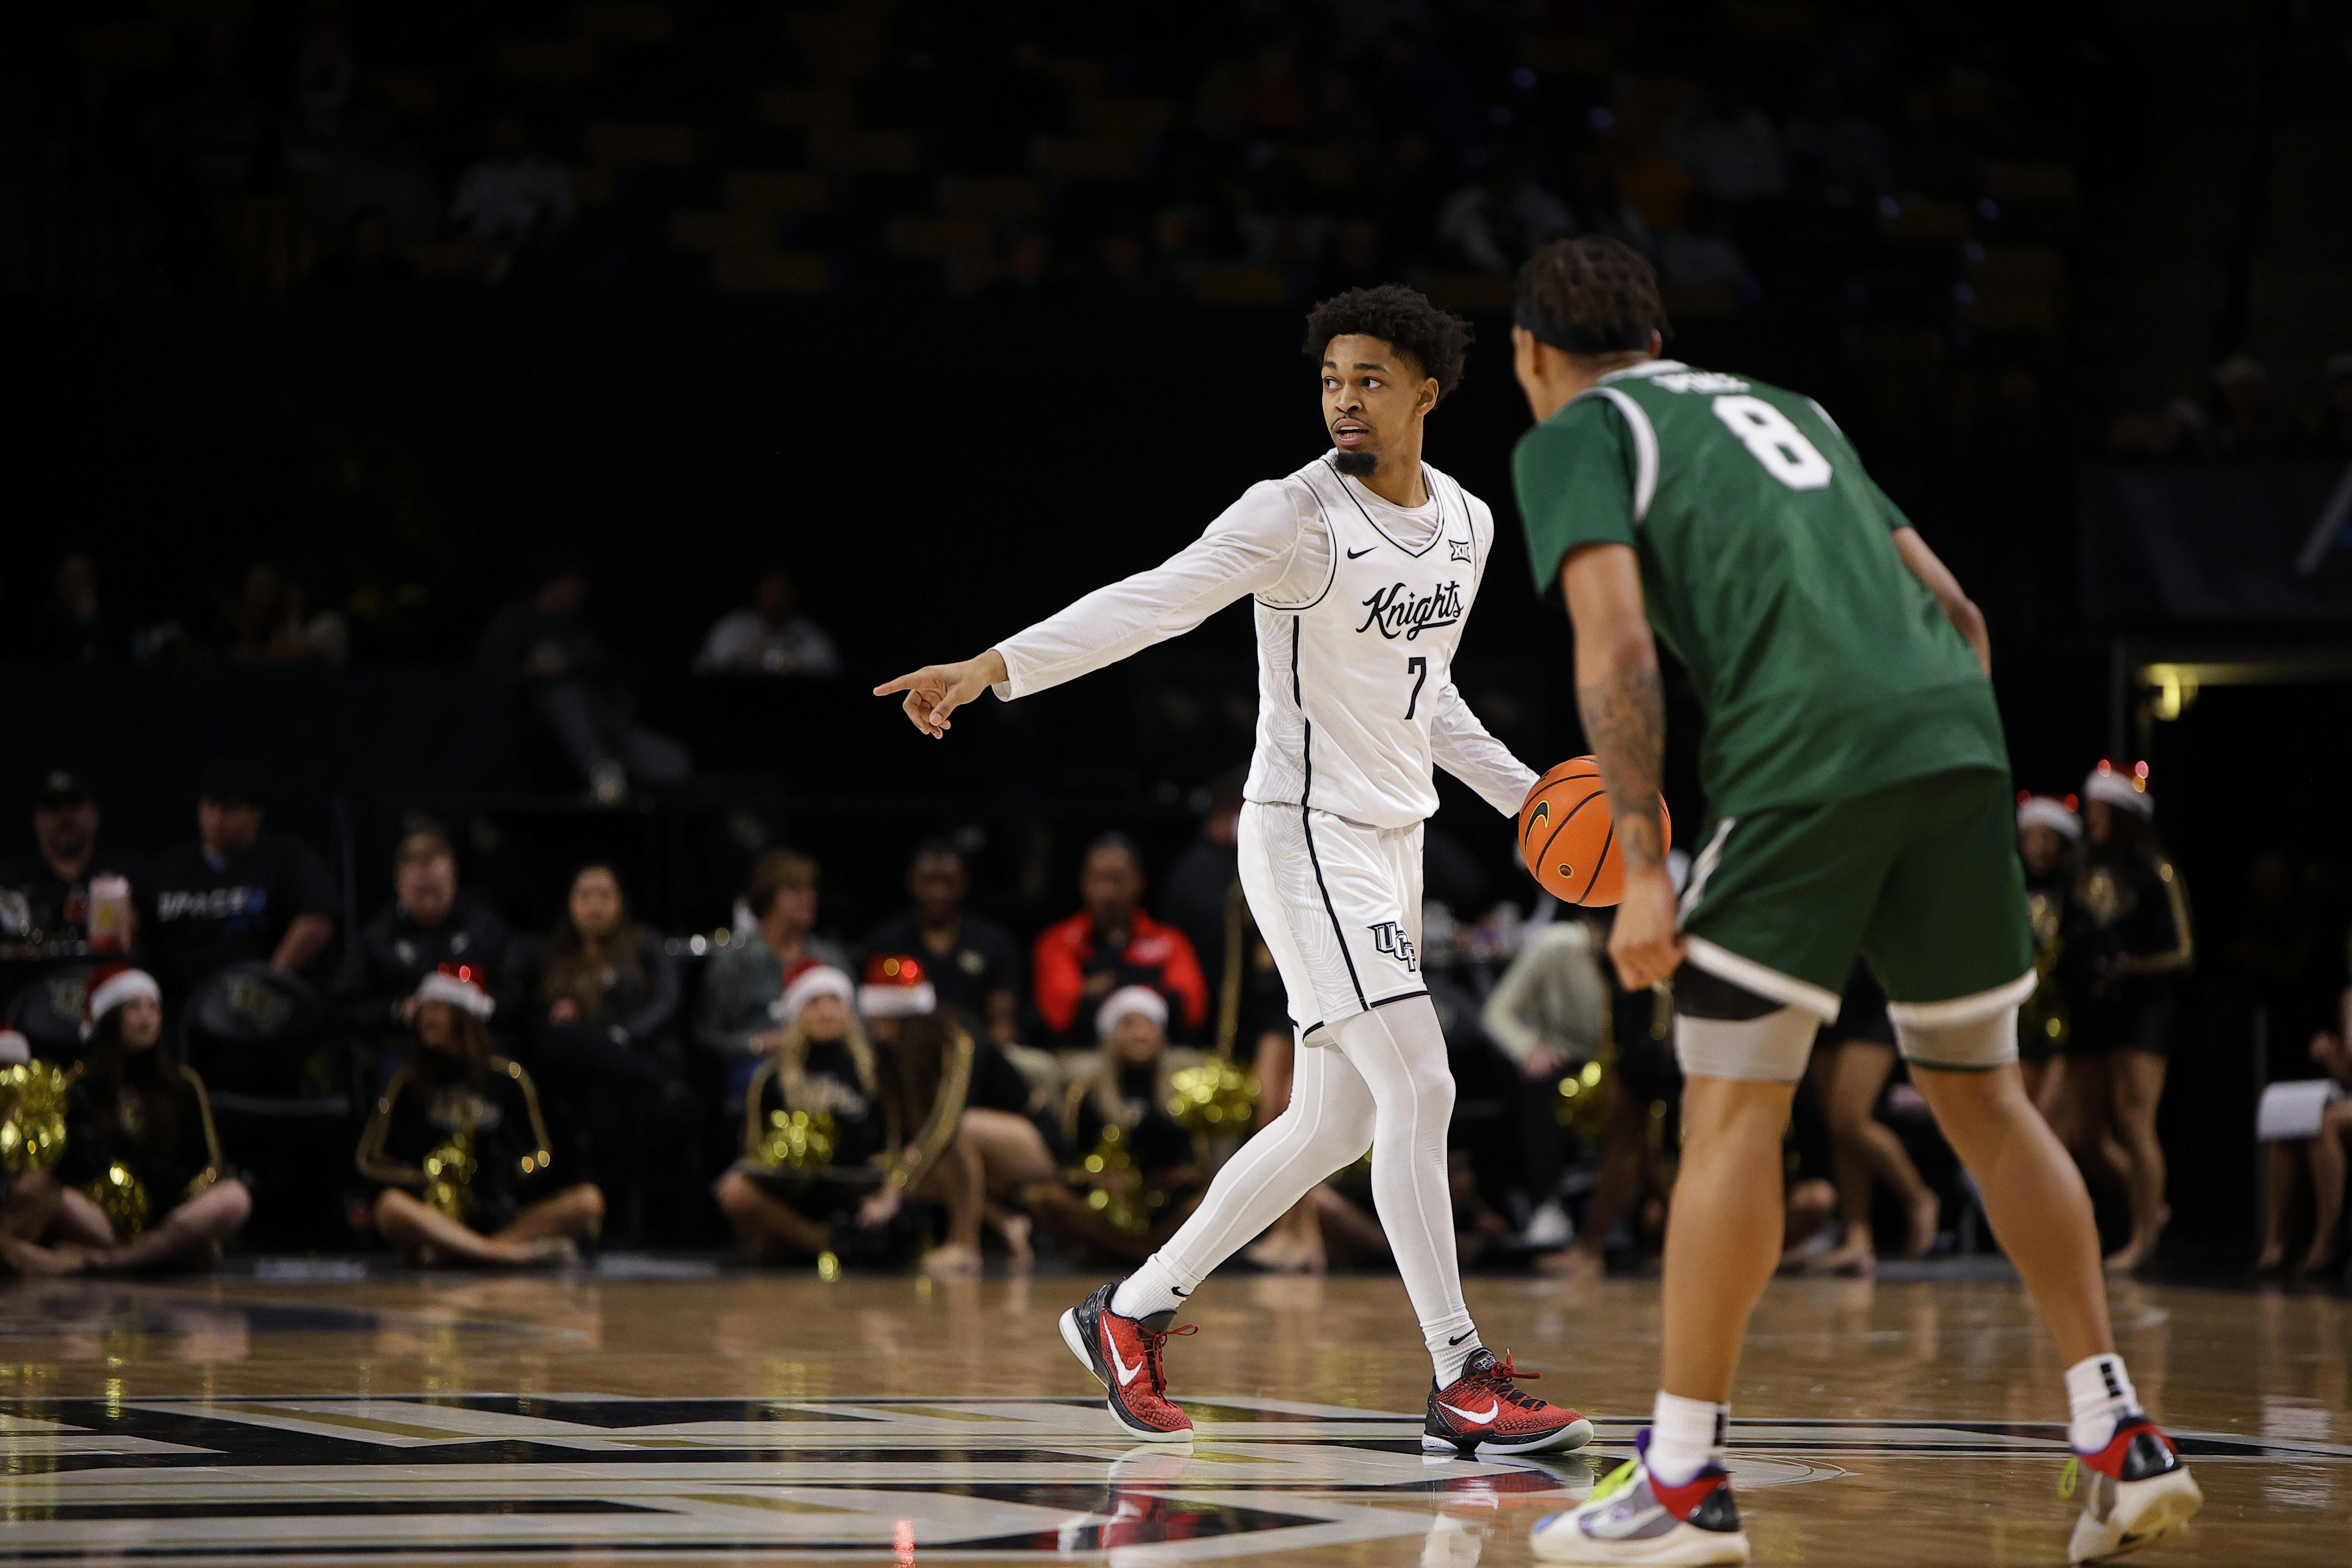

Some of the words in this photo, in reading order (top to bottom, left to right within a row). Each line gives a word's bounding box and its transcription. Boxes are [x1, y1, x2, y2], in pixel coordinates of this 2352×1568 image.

[1712, 395, 1833, 490] 8
[1356, 580, 1464, 641] Knights
[1404, 657, 1427, 720] 7
[1366, 921, 1416, 972] UCF
